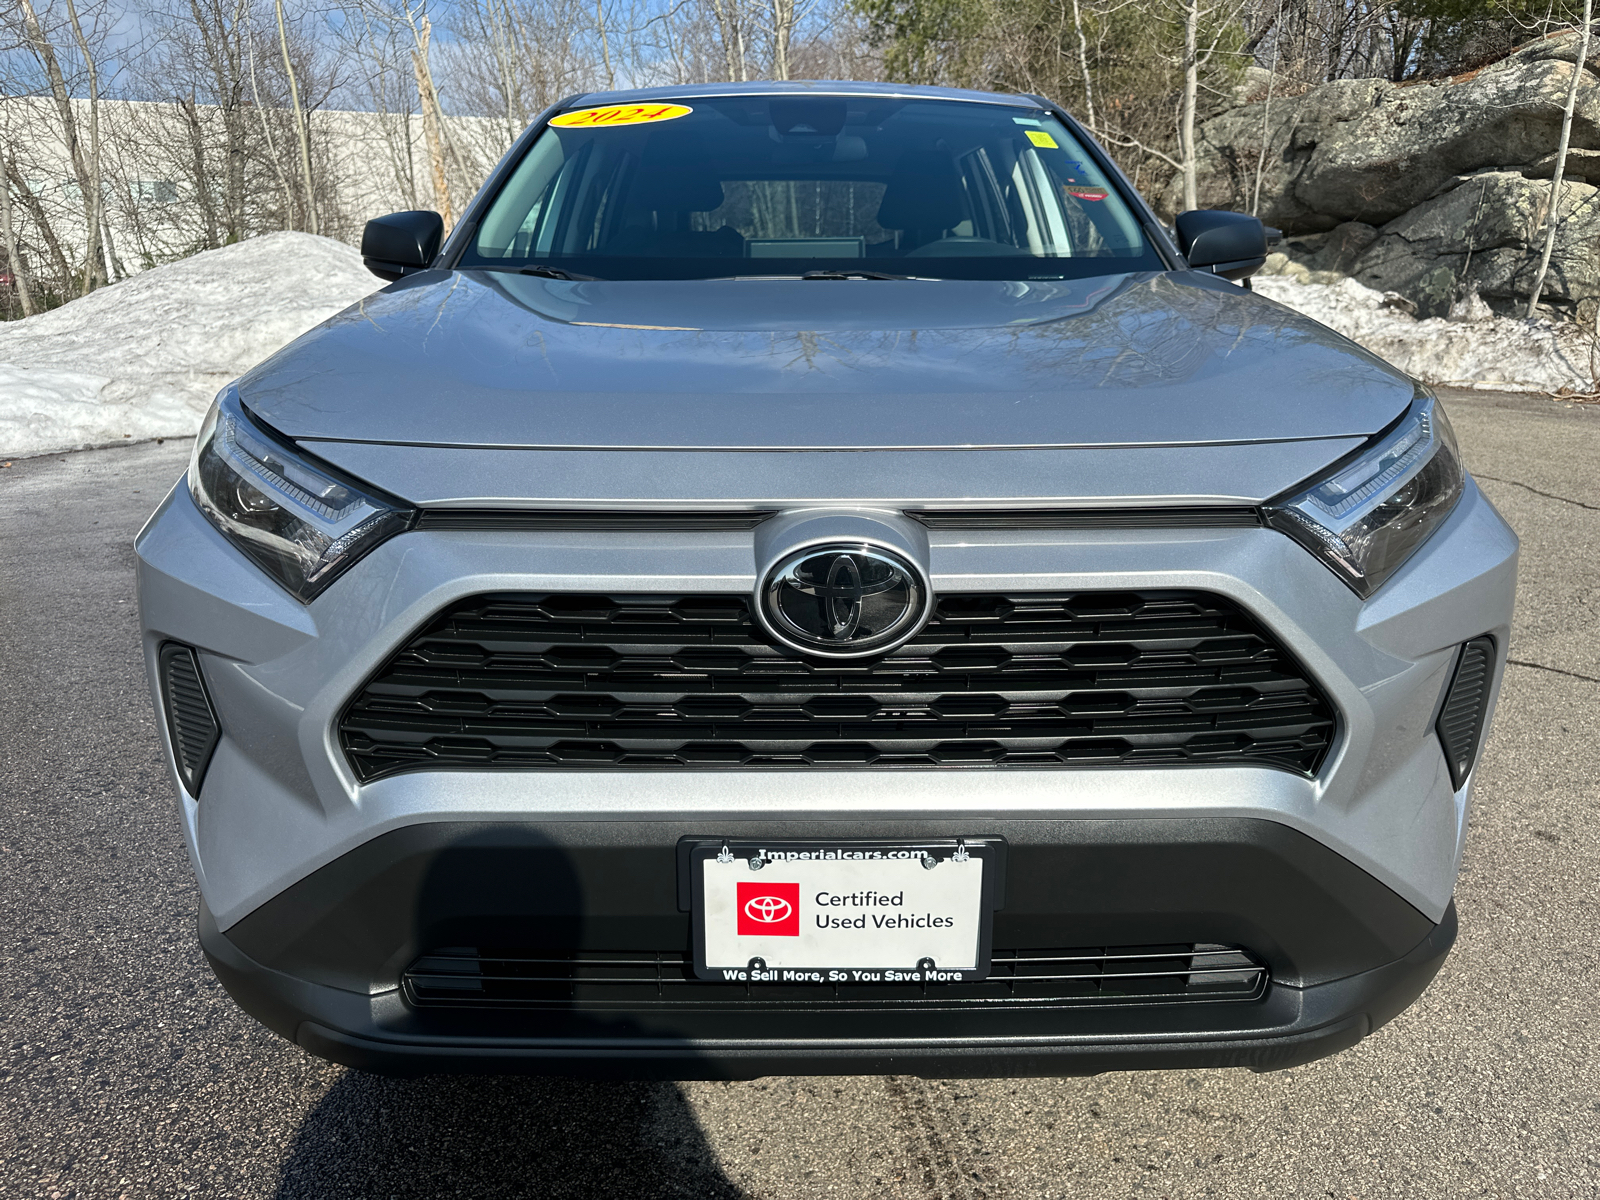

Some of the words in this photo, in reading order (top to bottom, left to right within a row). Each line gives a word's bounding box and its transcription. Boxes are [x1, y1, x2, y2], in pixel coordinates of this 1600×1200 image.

[566, 106, 673, 125] 2024
[758, 849, 928, 862] Imperialcars.com
[815, 891, 904, 907] Certified
[816, 914, 866, 929] Used
[872, 913, 954, 929] Vehicles
[723, 970, 747, 981] We
[751, 970, 778, 981] Sell
[783, 970, 825, 983] More,
[828, 970, 848, 981] So
[852, 970, 880, 981] You
[884, 970, 920, 981] Save
[925, 970, 963, 981] More
